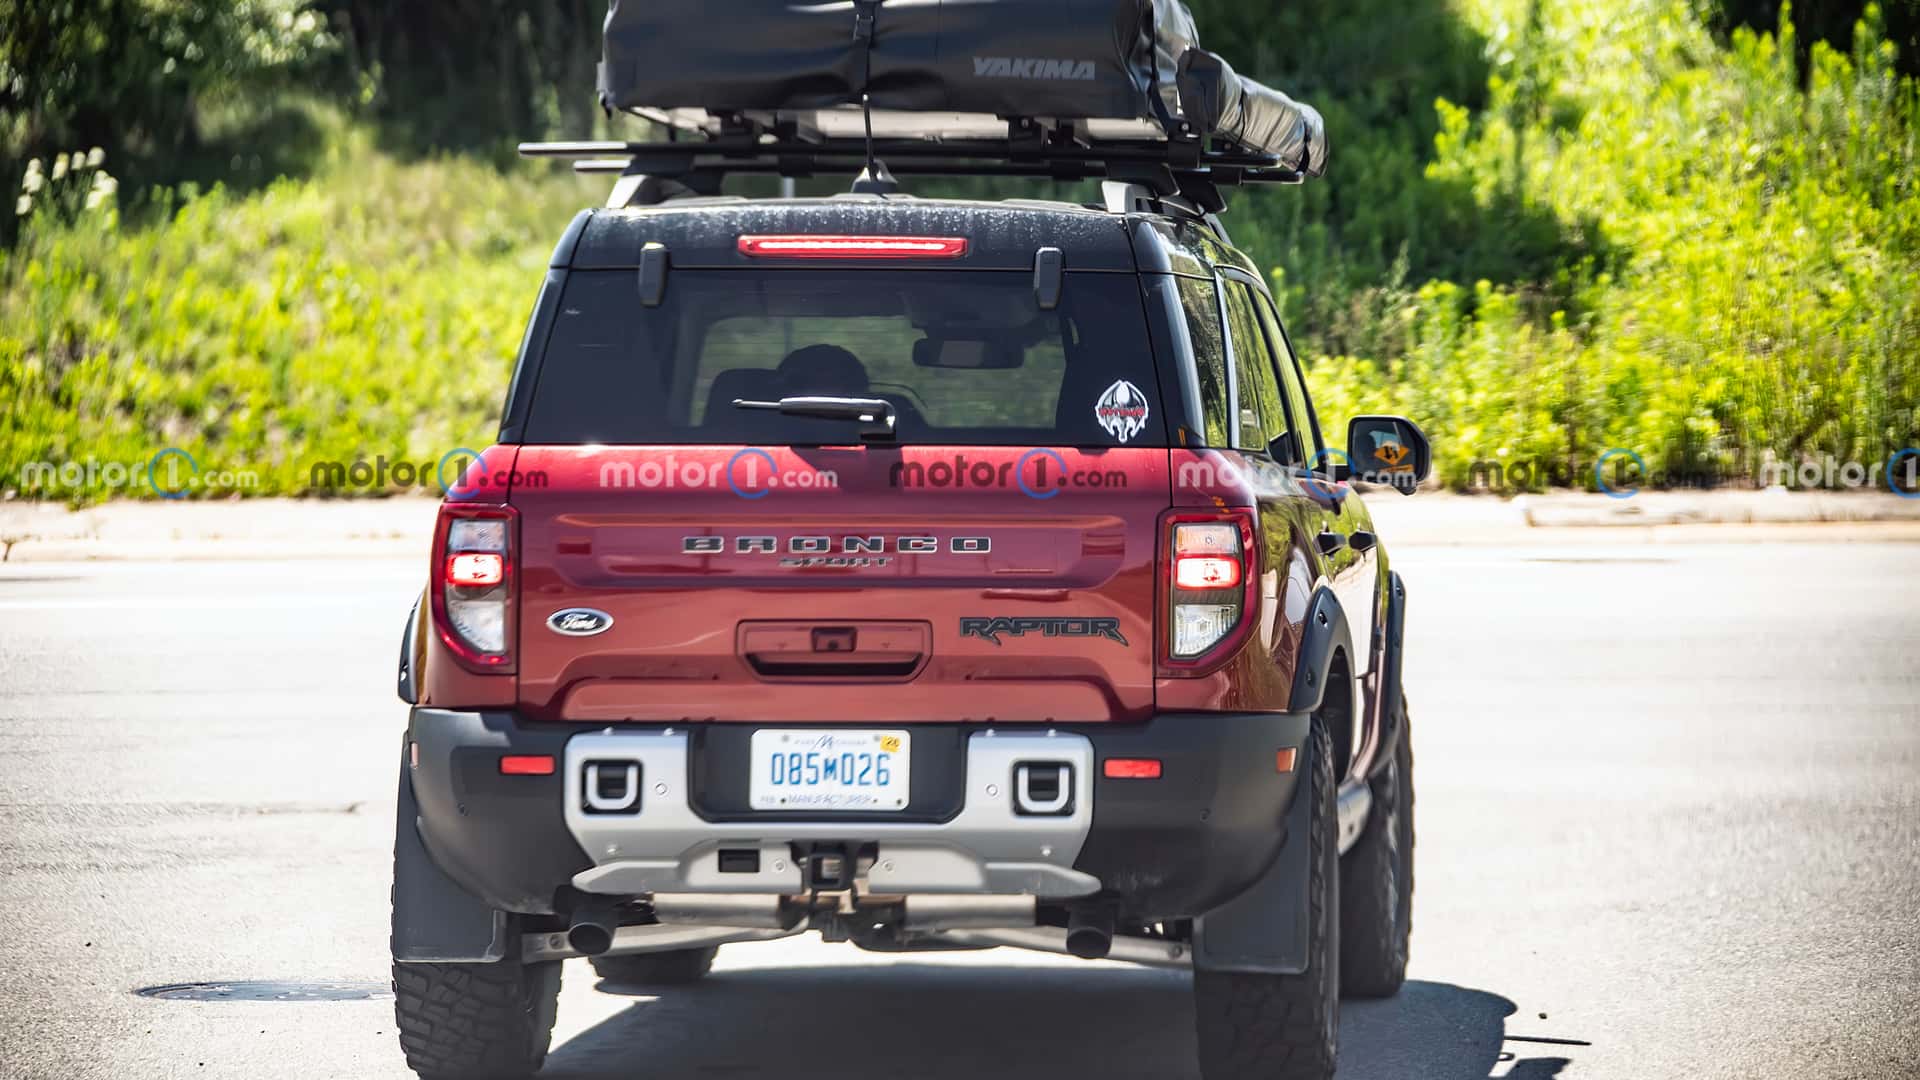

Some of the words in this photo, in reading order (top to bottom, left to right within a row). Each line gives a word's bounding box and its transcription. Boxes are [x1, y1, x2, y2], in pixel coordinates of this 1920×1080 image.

[972, 57, 1096, 80] YAKIMA
[681, 536, 992, 554] BRONCO
[779, 556, 893, 568] SPORT
[960, 616, 1129, 647] RAPTOR
[771, 752, 891, 786] 085M026
